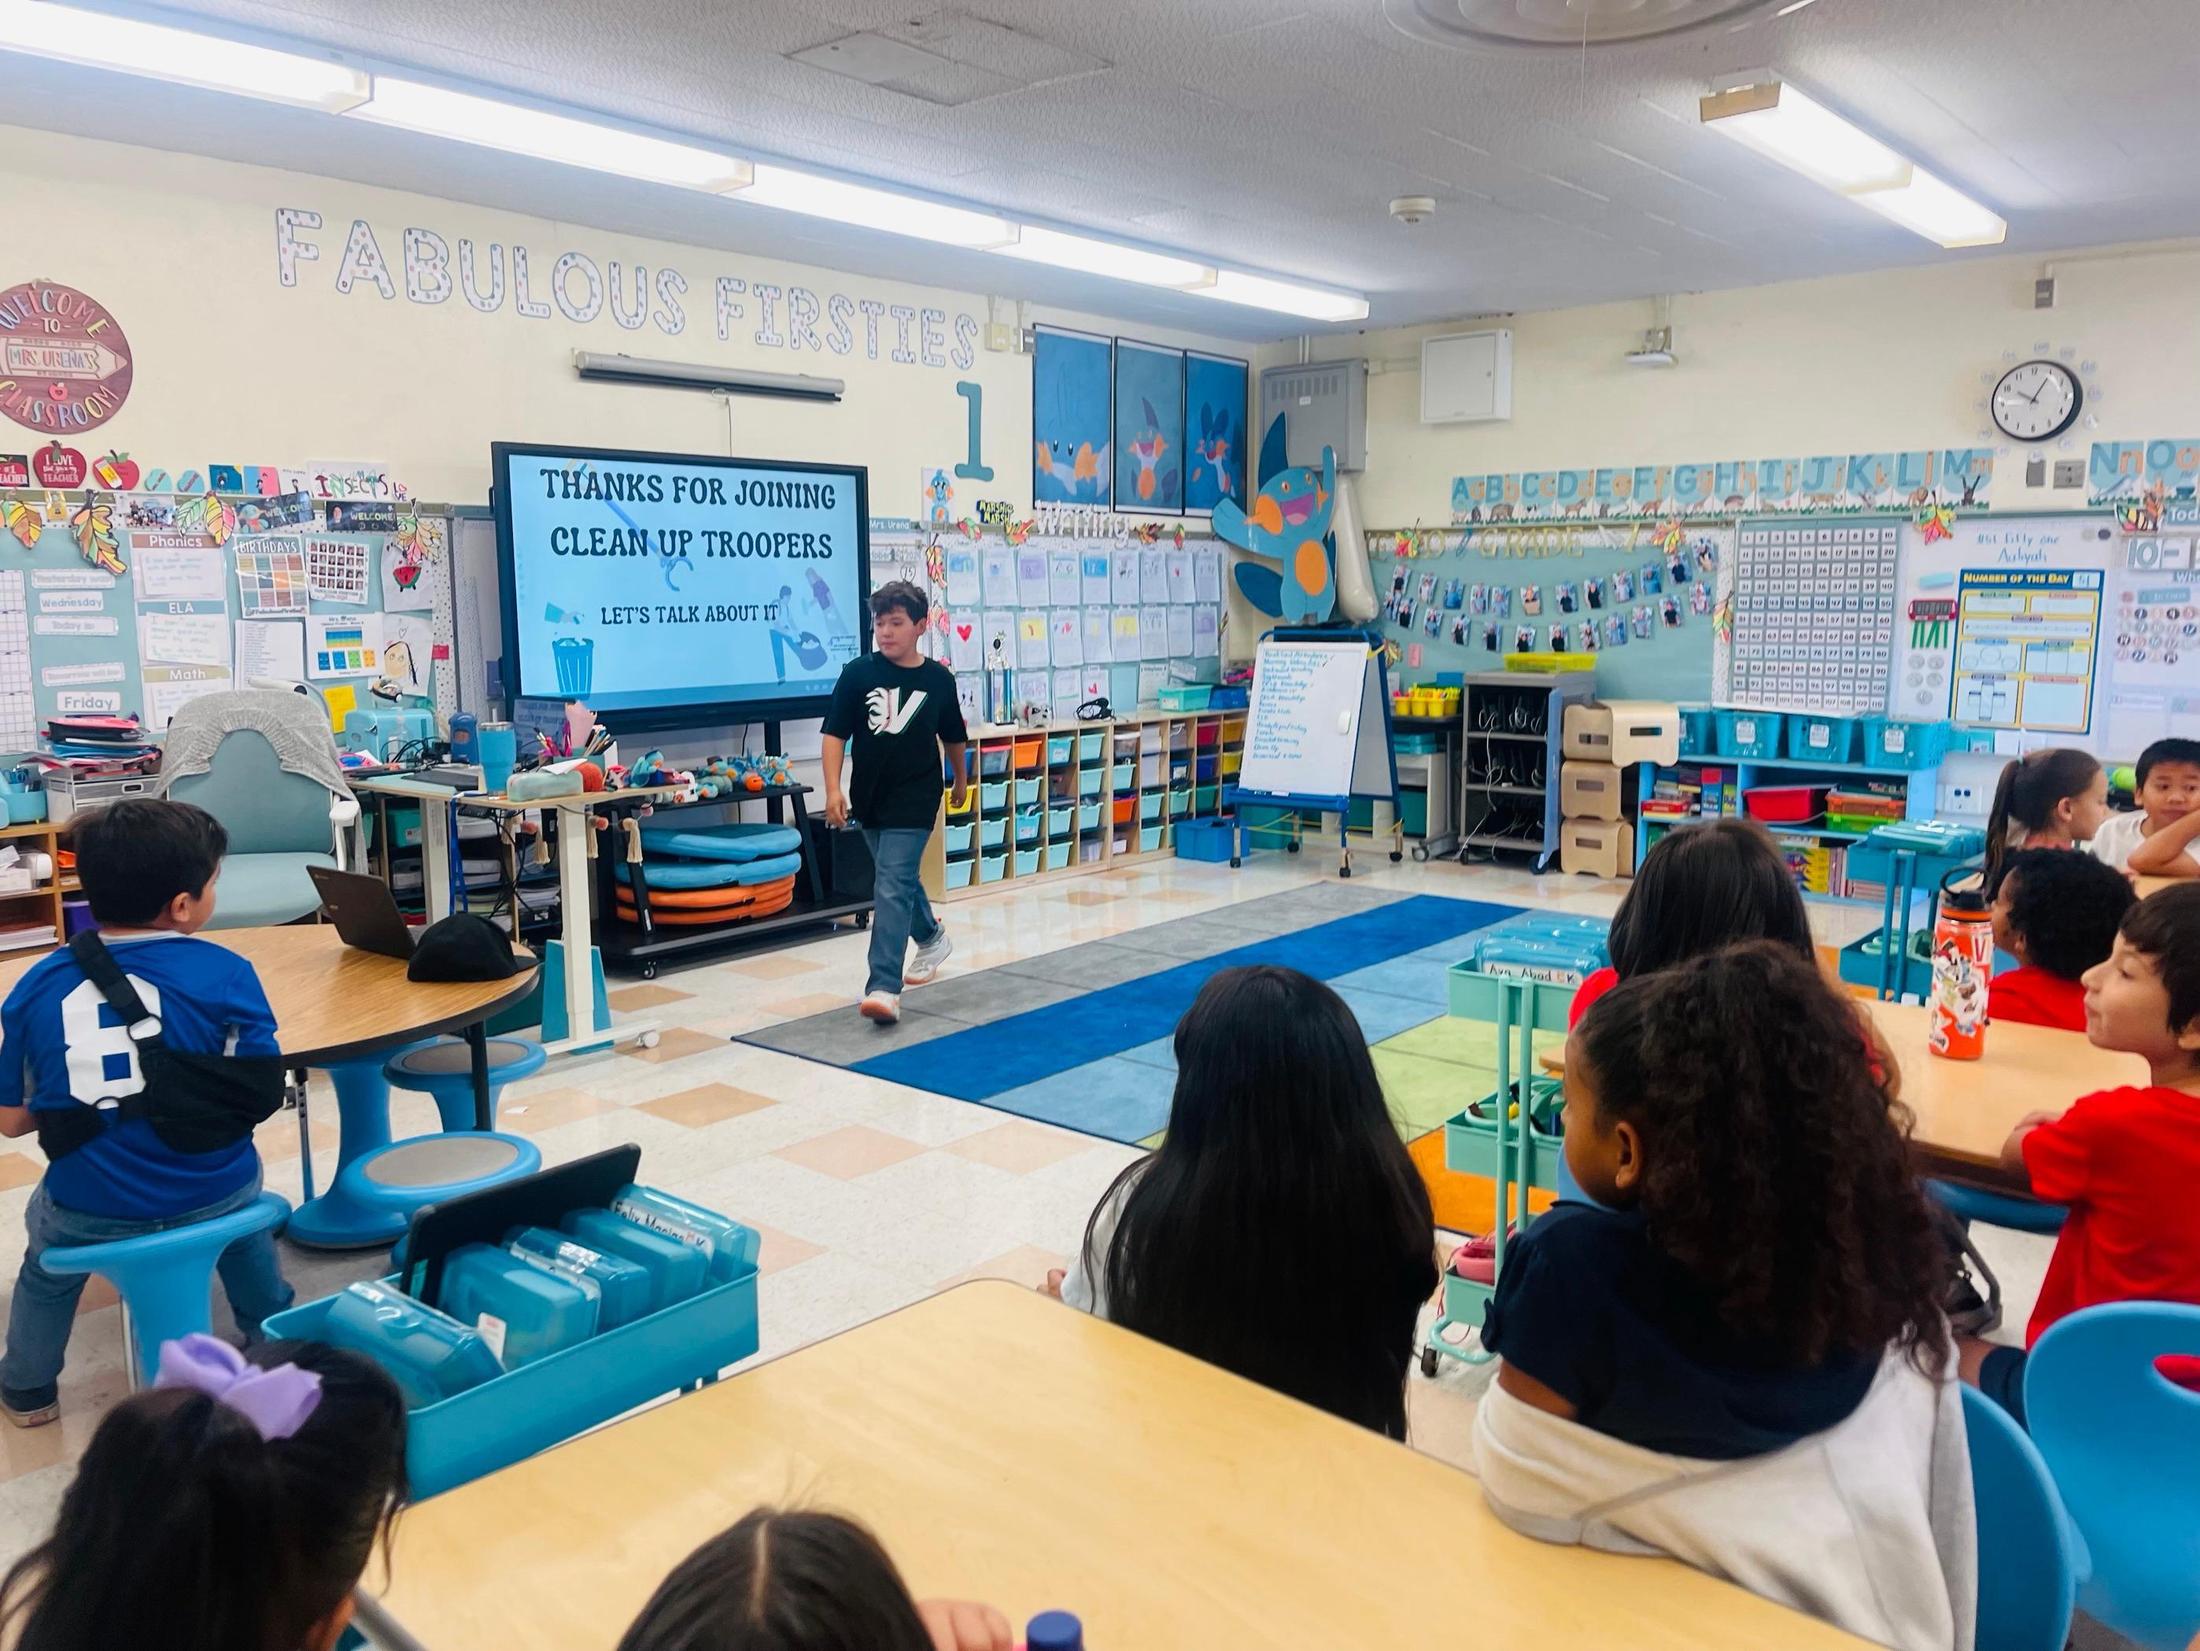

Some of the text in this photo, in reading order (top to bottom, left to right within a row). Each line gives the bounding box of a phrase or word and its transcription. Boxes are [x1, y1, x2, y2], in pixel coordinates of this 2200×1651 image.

[275, 207, 978, 370] FABULOUS FIRSTIES
[0, 289, 110, 338] WELCOME
[42, 317, 61, 333] TO
[0, 380, 119, 428] CLASSROOM
[954, 381, 994, 481] 1
[315, 471, 389, 499] INSECTS
[540, 469, 836, 509] THANKS FOR JOINING
[1034, 499, 1129, 548] Writing
[149, 535, 203, 548] Phonics
[239, 540, 297, 554] BIRTHDAYS
[551, 527, 833, 559] CLEAN UP TROOPERS
[42, 598, 102, 609] Wednesday
[169, 602, 194, 614] ELA
[601, 604, 779, 625] LET'S TALK ABOUT IT
[169, 669, 206, 680] Math
[64, 696, 113, 709] Friday
